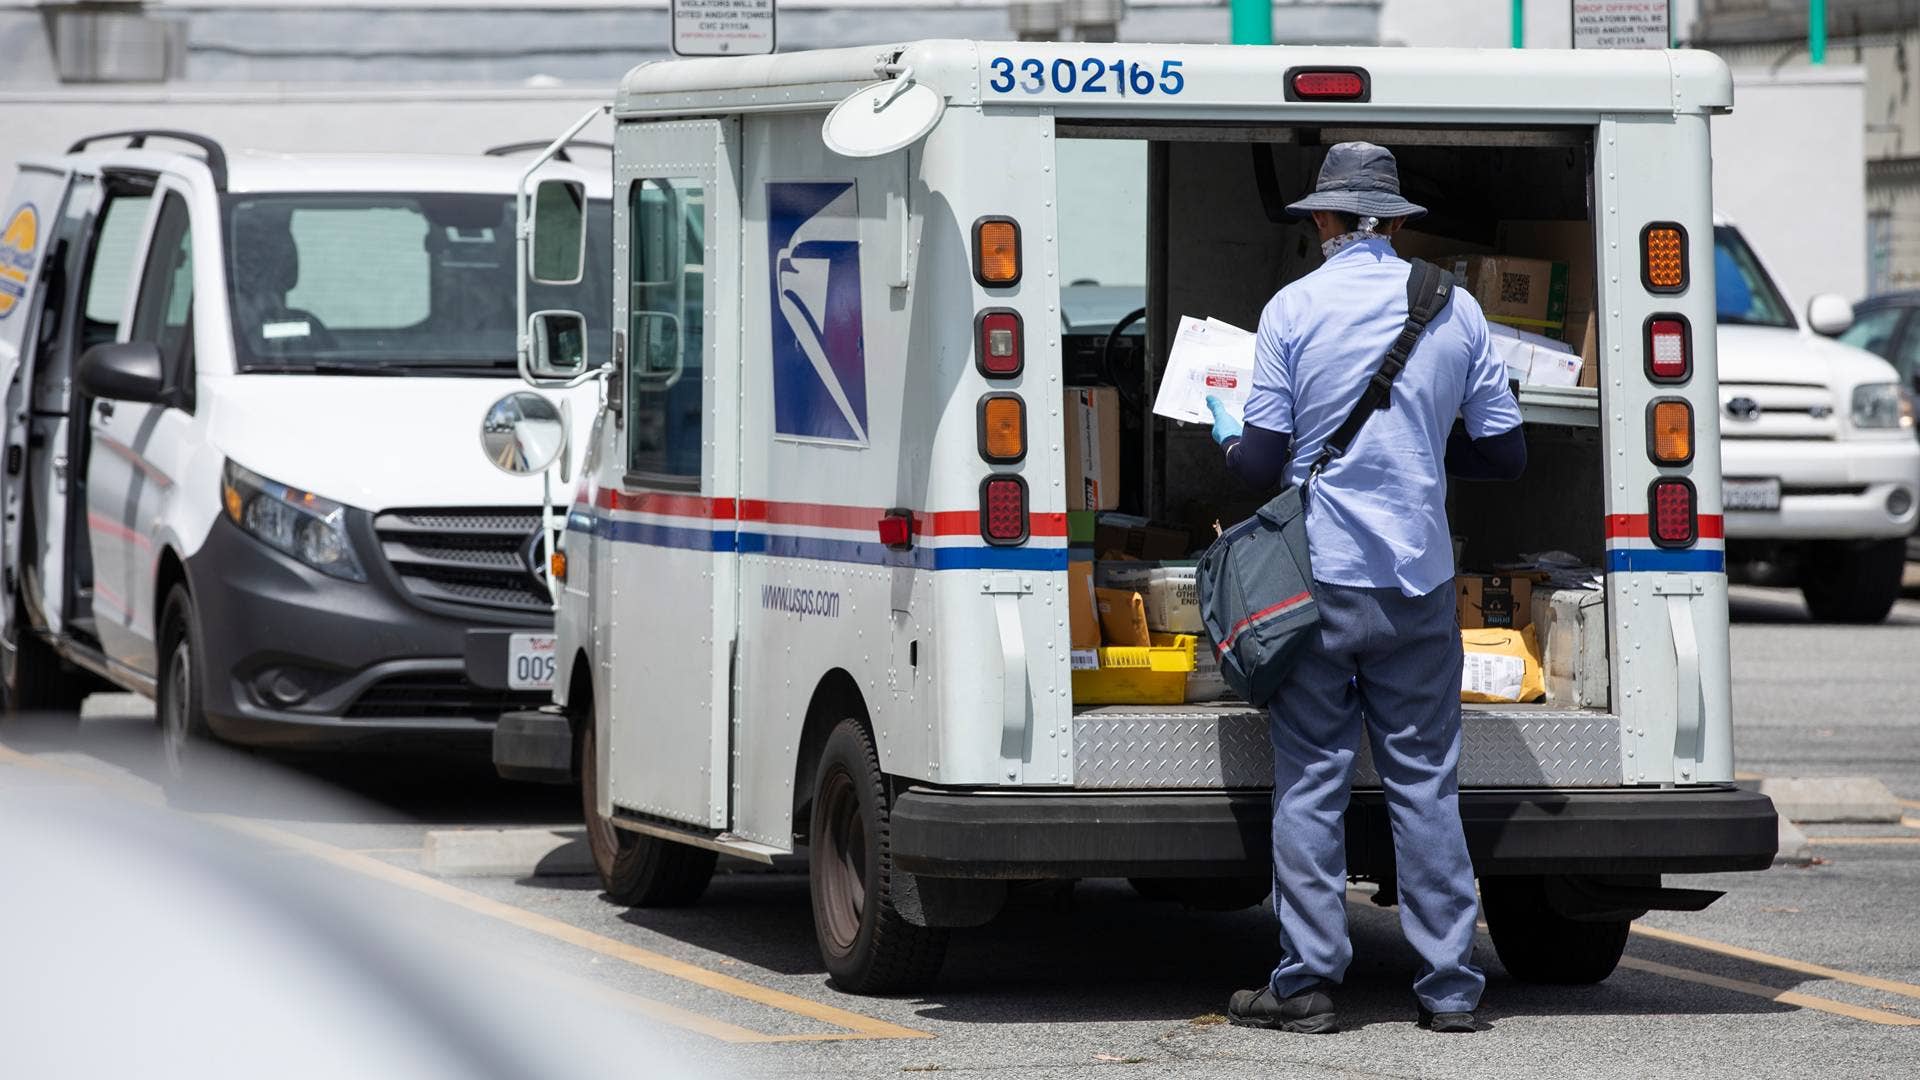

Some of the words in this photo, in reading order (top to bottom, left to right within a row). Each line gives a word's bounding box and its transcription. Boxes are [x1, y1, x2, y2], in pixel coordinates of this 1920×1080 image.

[1580, 15, 1626, 23] VIOLATORS
[1629, 15, 1648, 23] WILL
[1575, 26, 1600, 35] CITED
[1637, 25, 1666, 33] TOWED
[1597, 37, 1615, 45] CVC
[990, 57, 1184, 97] 3302165
[761, 584, 840, 622] www.usps.com
